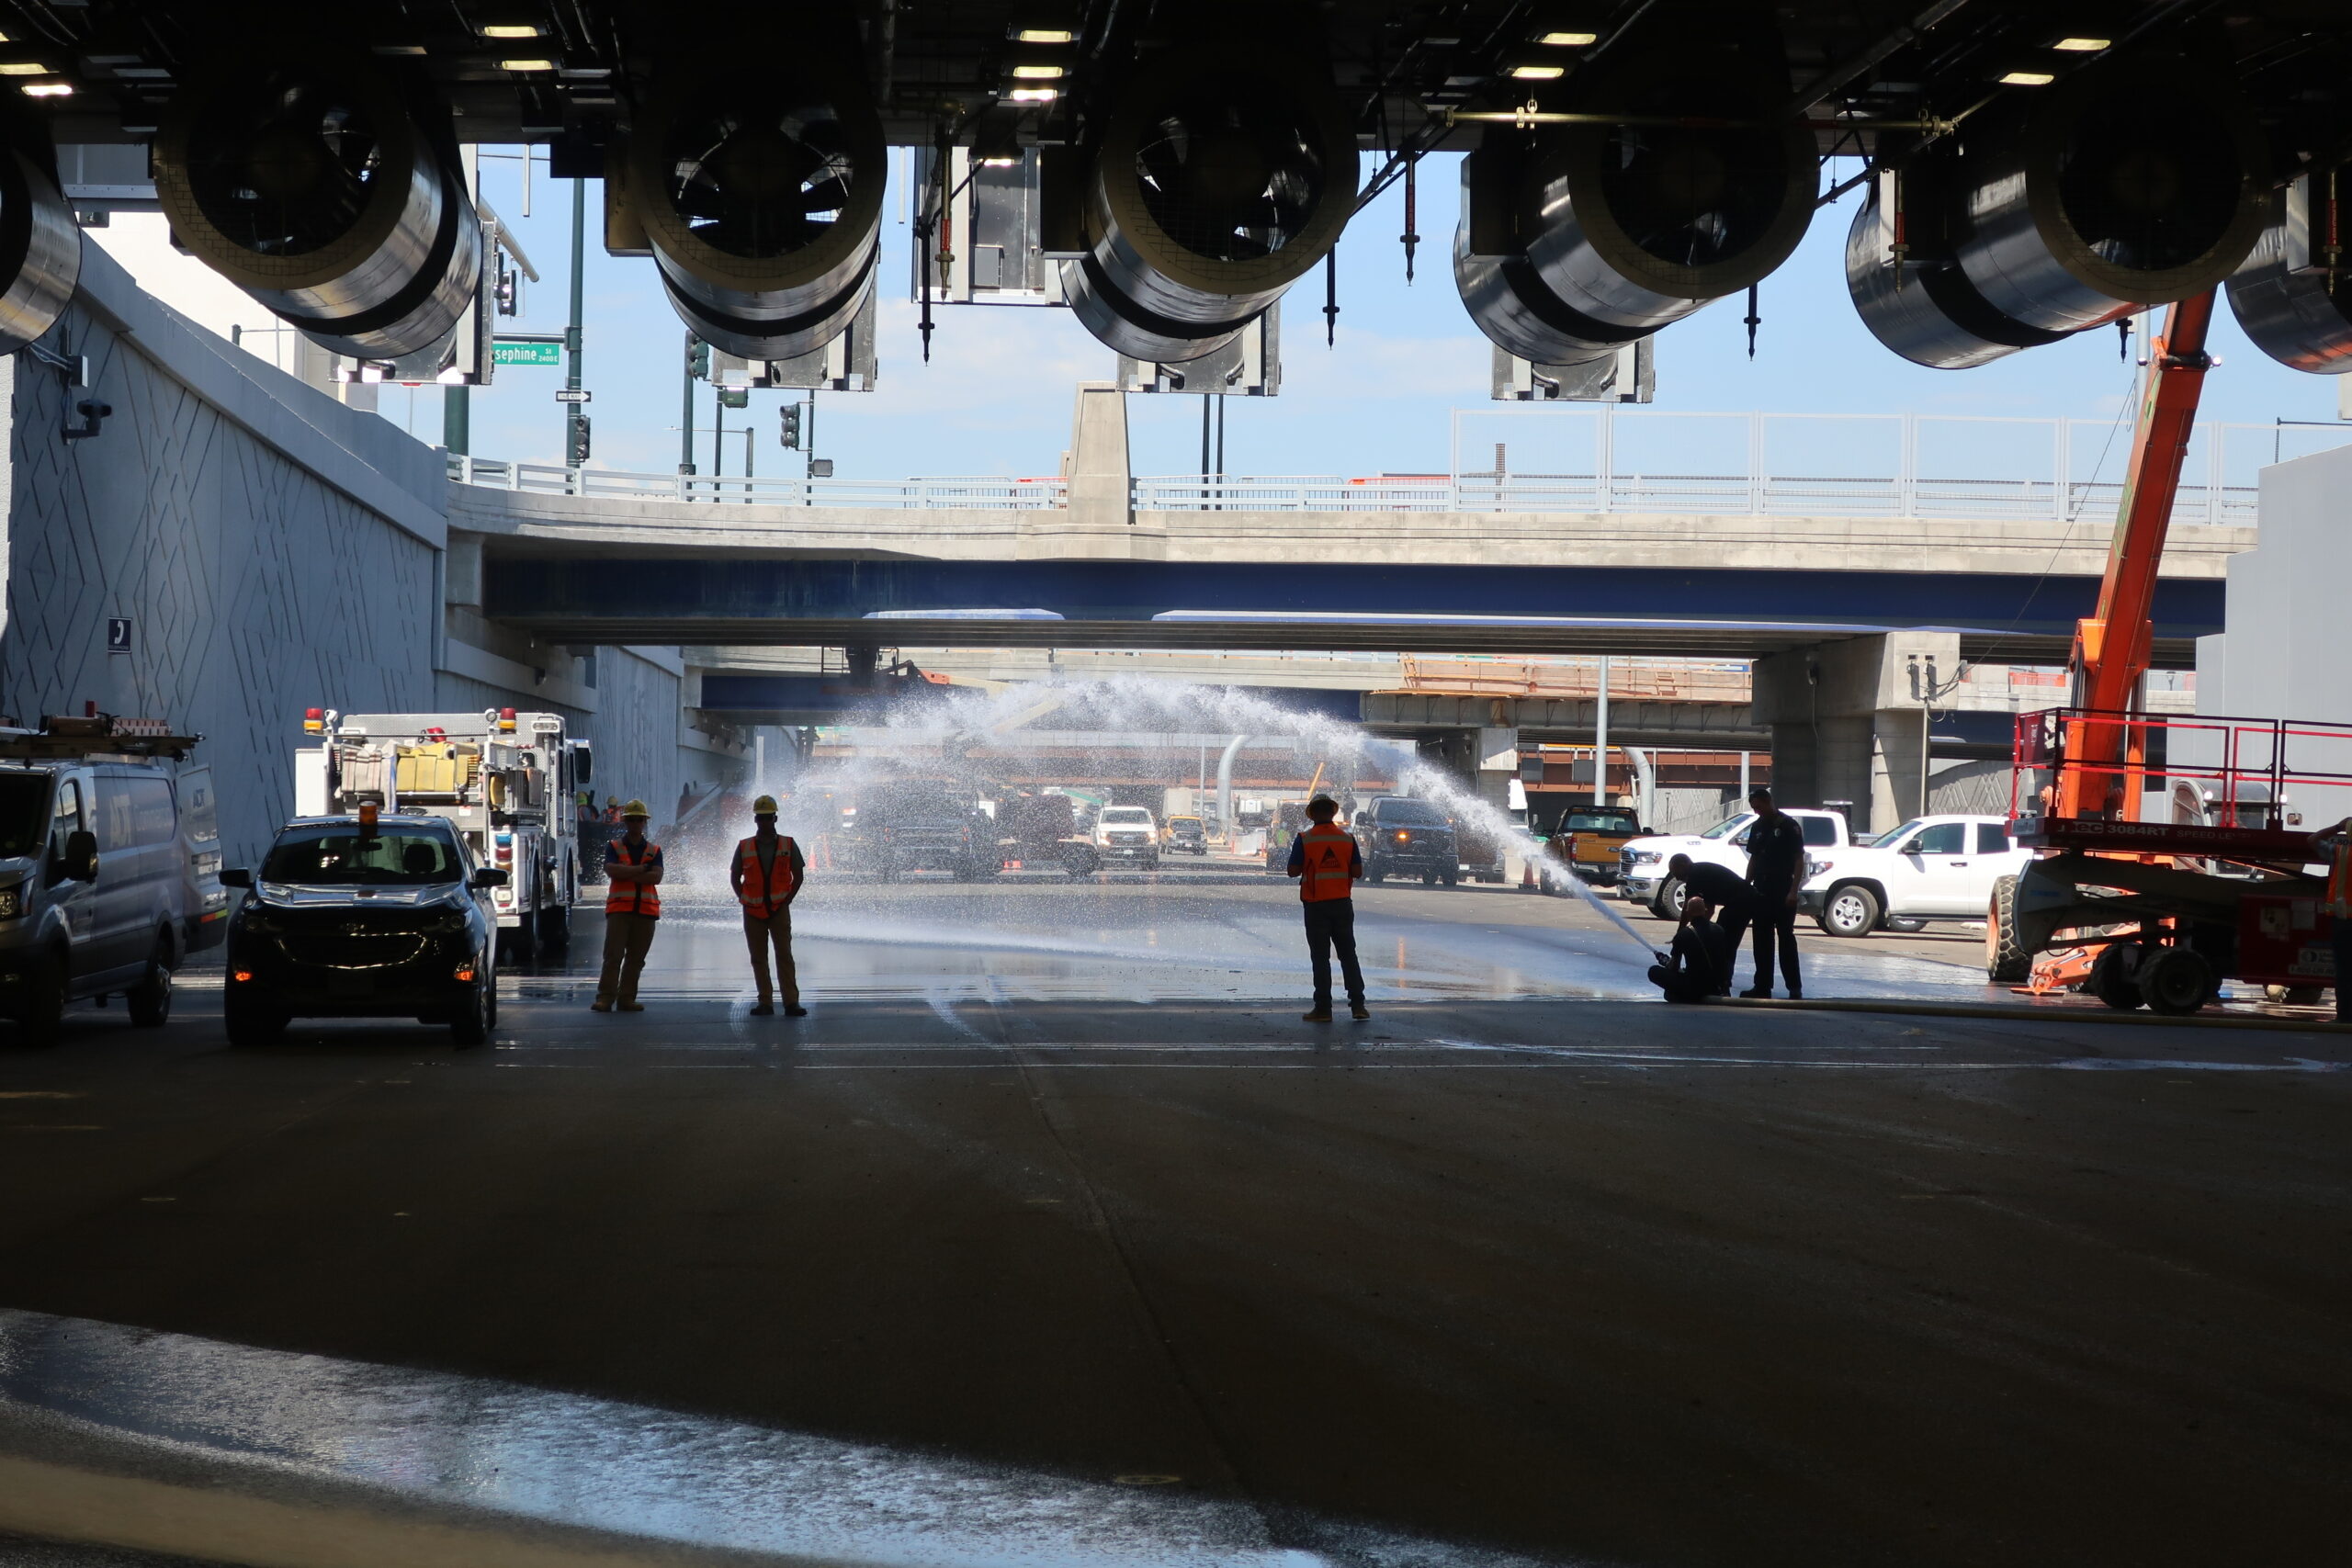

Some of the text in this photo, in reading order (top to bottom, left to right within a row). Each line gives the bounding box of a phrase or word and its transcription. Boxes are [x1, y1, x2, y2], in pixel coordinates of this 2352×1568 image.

[495, 347, 537, 364] sephine
[2107, 824, 2169, 837] 3084RT
[2177, 829, 2215, 839] SPEED
